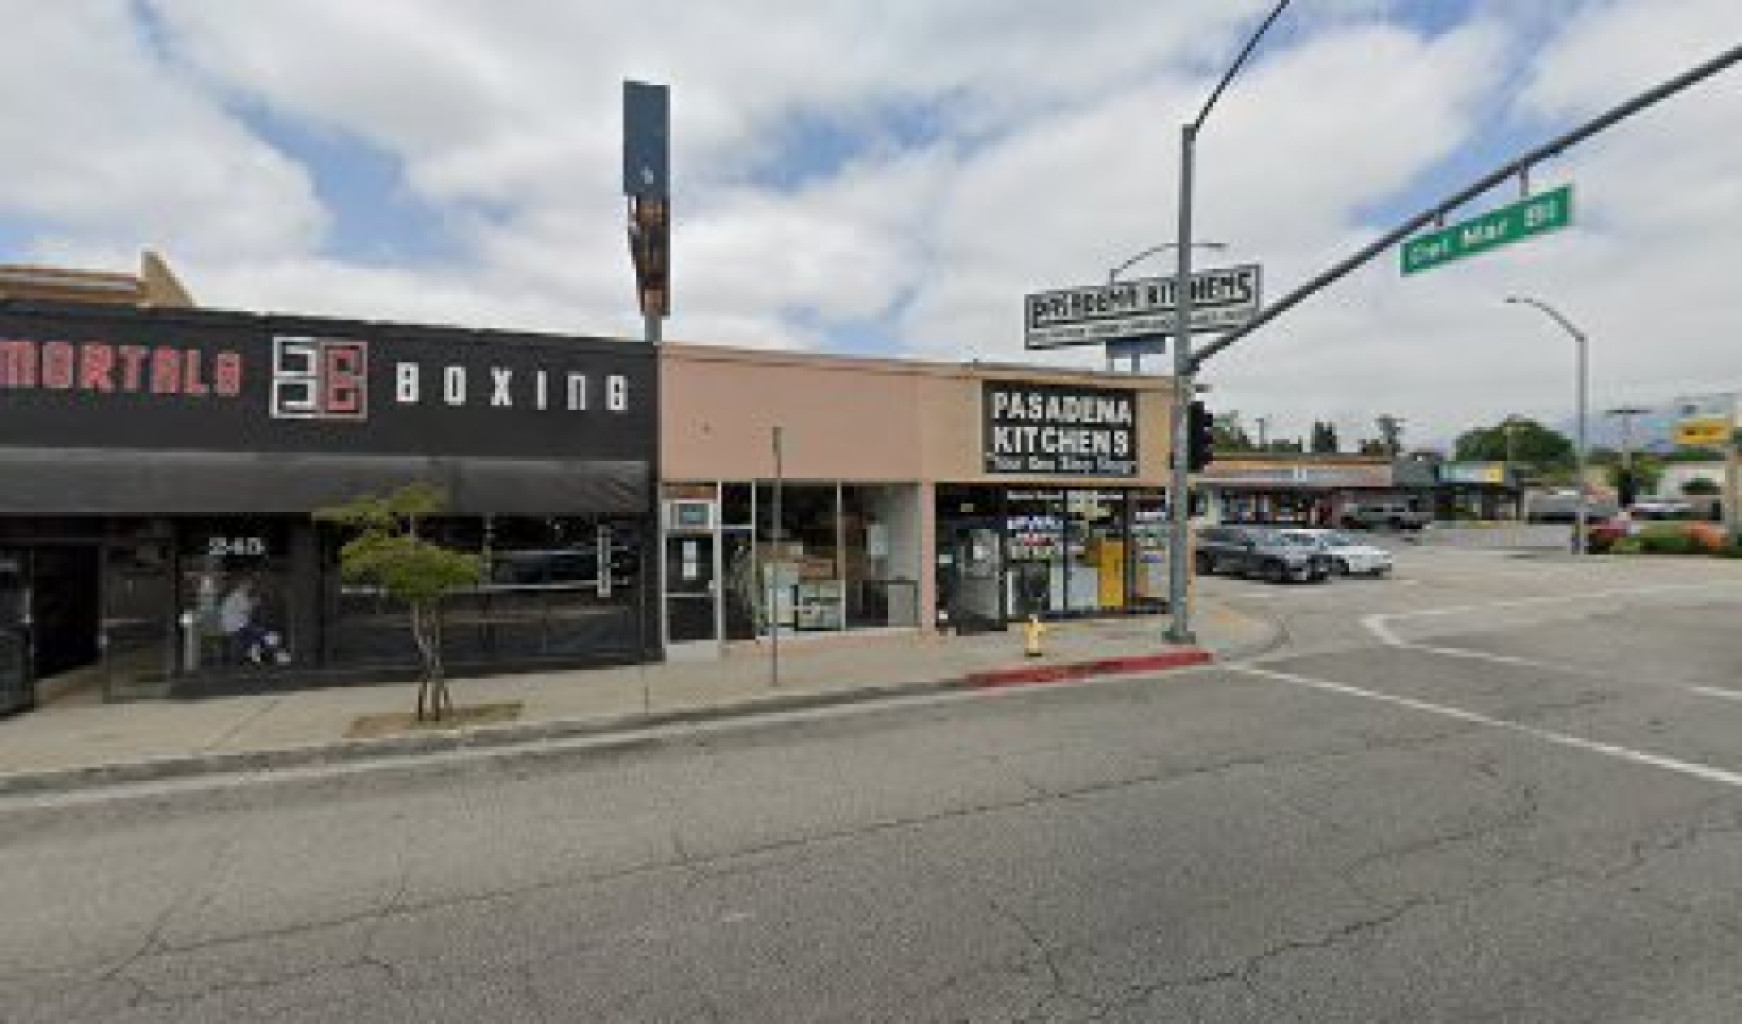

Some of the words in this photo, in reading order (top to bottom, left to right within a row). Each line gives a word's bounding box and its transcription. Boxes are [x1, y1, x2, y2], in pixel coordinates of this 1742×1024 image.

[1461, 217, 1509, 249] Mar
[396, 362, 629, 413] BOXING
[991, 392, 1132, 427] PASADENA
[993, 426, 1129, 457] KITCHENS
